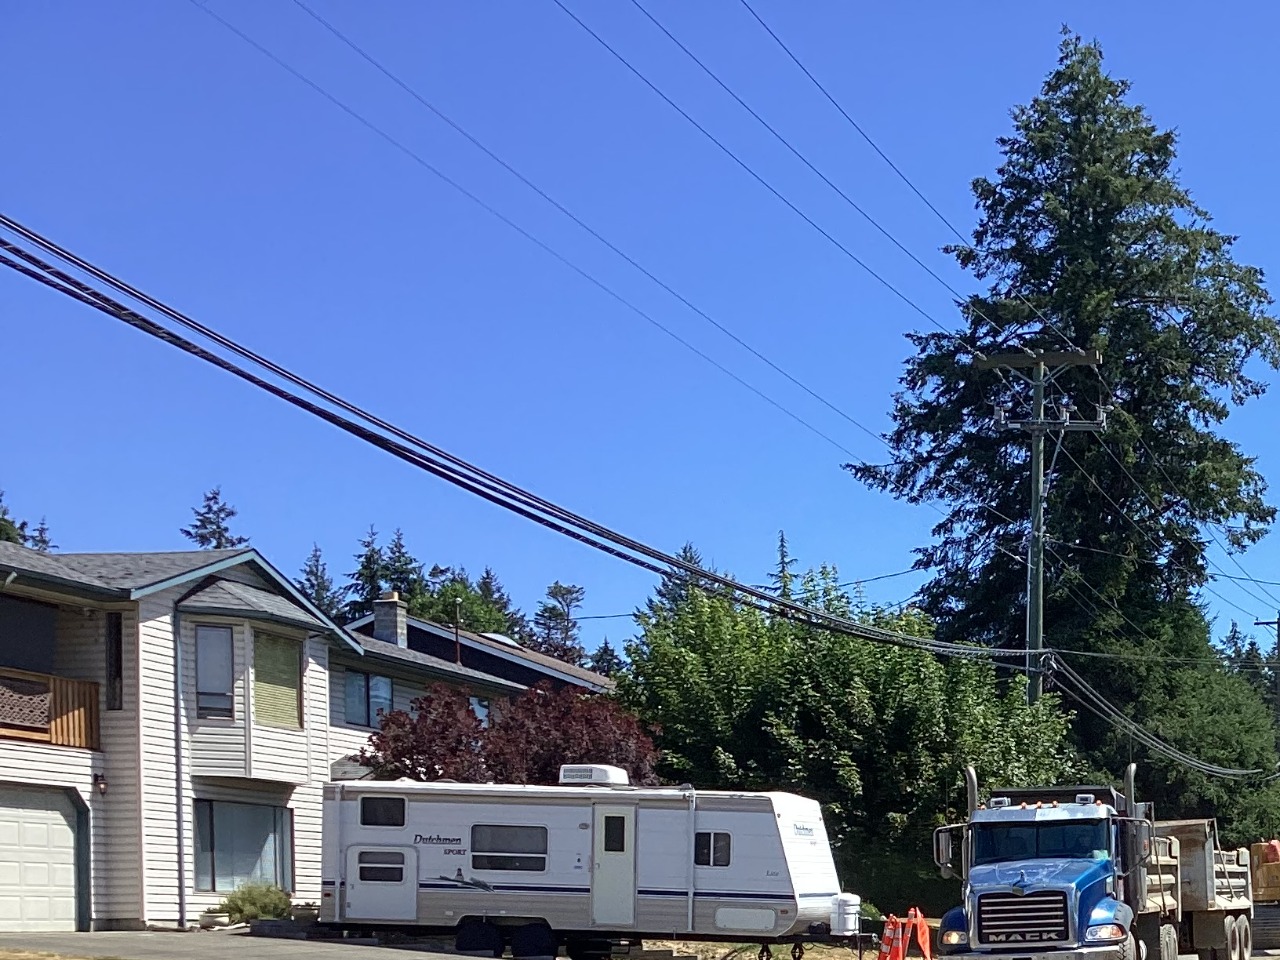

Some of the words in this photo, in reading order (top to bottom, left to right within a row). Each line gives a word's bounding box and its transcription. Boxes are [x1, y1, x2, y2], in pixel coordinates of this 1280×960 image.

[413, 834, 461, 845] Dutchmen
[444, 848, 467, 856] SPORT
[988, 932, 1060, 942] MACK
